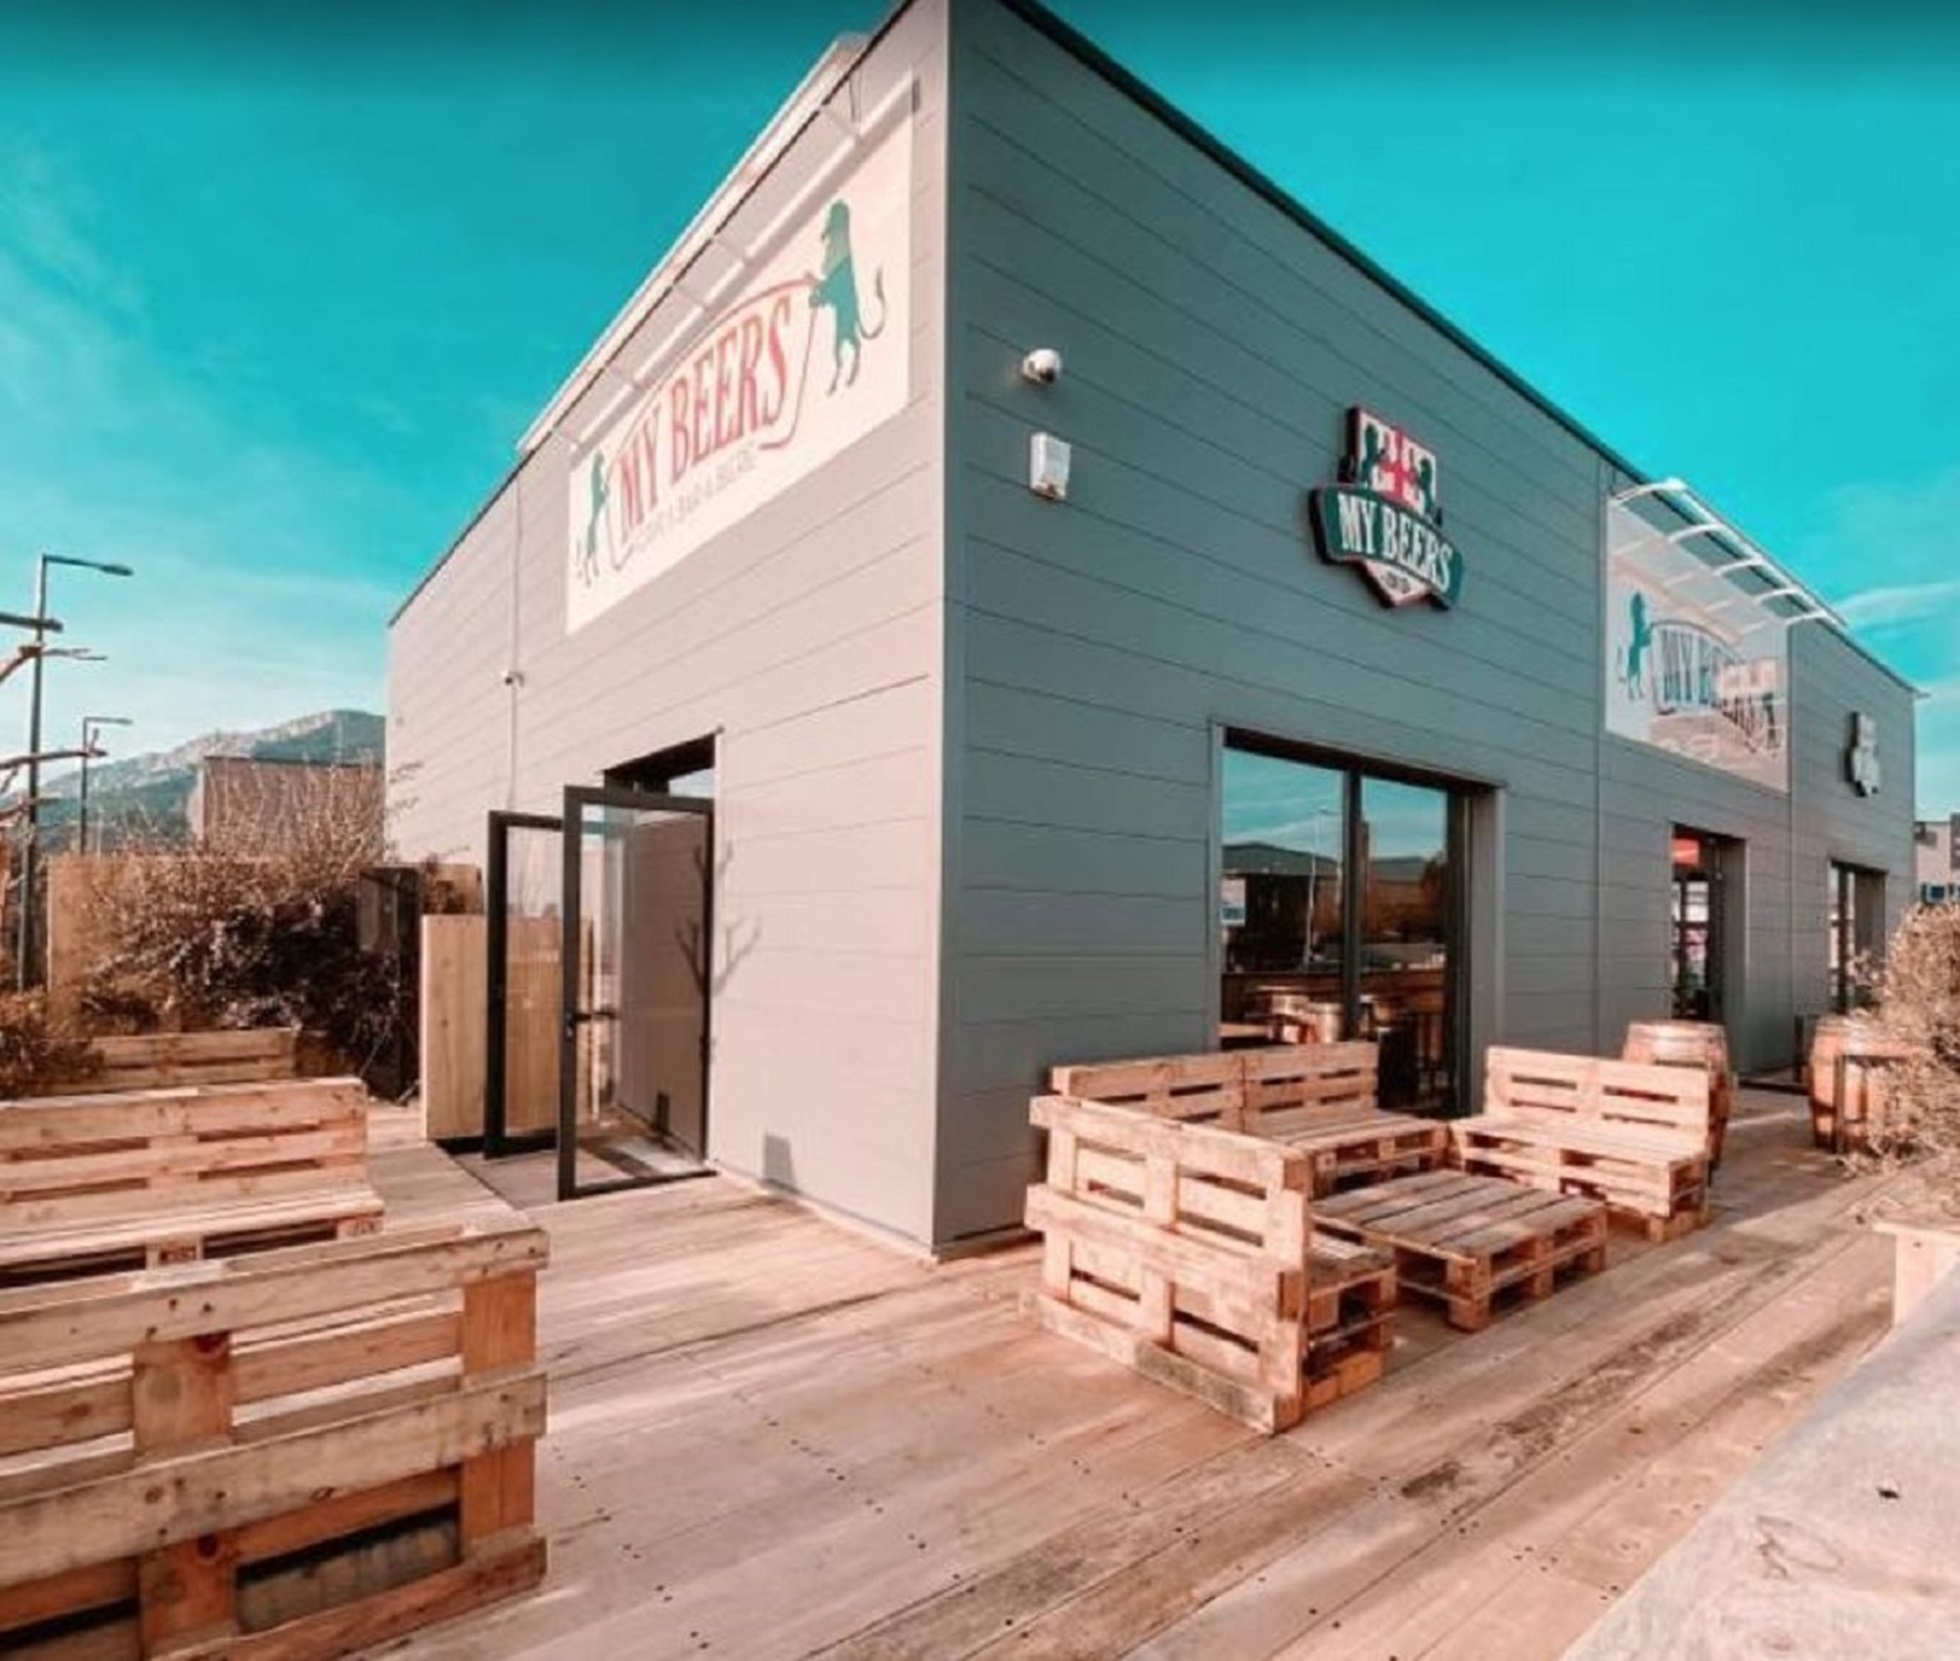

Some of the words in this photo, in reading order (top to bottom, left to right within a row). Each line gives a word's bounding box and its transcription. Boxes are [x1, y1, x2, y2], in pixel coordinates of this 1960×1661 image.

[619, 403, 661, 544] MY
[670, 294, 791, 486] BEERS
[1337, 493, 1378, 554] MY
[1382, 506, 1453, 593] BEERS
